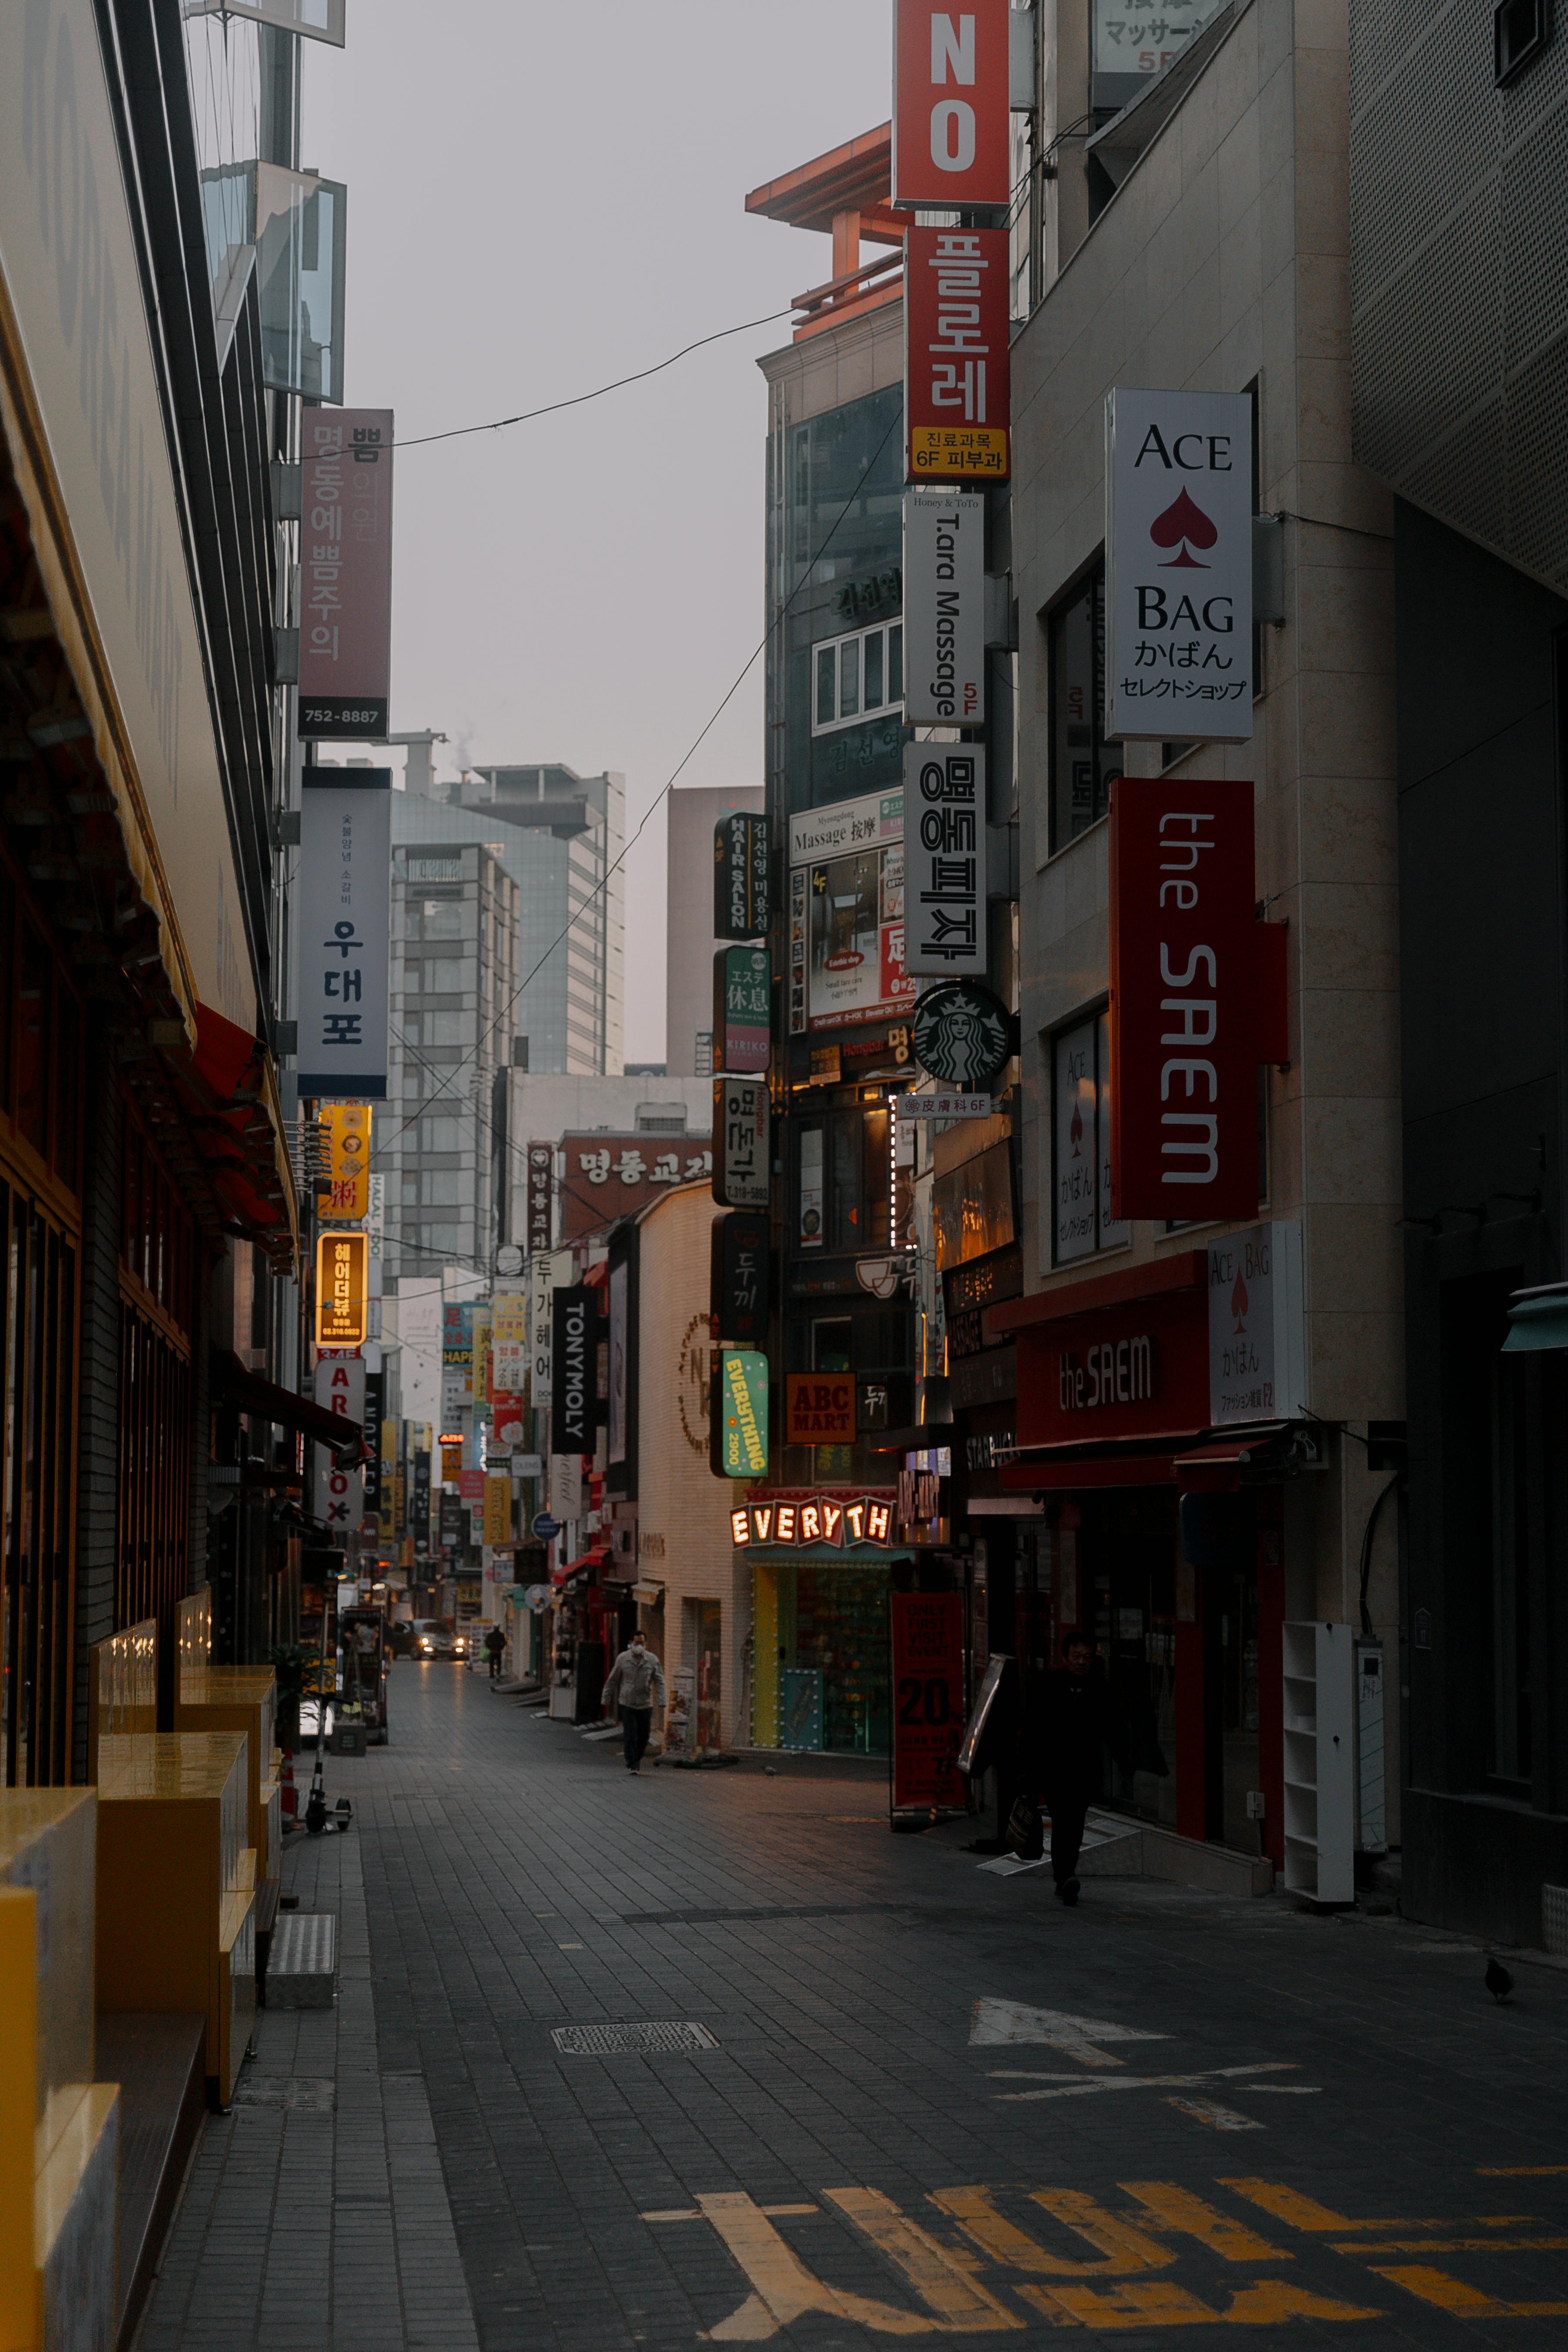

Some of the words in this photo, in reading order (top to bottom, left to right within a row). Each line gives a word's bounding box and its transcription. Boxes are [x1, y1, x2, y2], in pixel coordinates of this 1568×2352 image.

[1139, 51, 1176, 71] 5F
[930, 13, 976, 171] NO
[928, 235, 988, 423] 플로레
[926, 432, 991, 449] 진료과목
[1134, 424, 1232, 471] ACE
[917, 452, 939, 467] 6F
[948, 451, 1002, 470] 피부과
[914, 497, 942, 508] Honey
[945, 498, 952, 507] &
[955, 499, 978, 508] ToTo
[308, 426, 344, 661] 명동예쁨주의
[1134, 586, 1233, 633] BAG
[930, 592, 960, 717] Massage
[1134, 641, 1232, 669] かばん
[963, 683, 978, 716] 5F
[1120, 677, 1246, 701] セレクトショップ
[305, 710, 378, 723] 752-8887
[731, 819, 745, 866] HAIR
[754, 822, 767, 875] 김선영
[795, 827, 846, 851] Massage
[920, 756, 976, 960] 명동피자
[1159, 813, 1215, 909] the
[731, 870, 745, 928] SALON
[754, 880, 769, 931] 미용실
[322, 921, 363, 1045] 우대포
[732, 971, 763, 984] エステ
[727, 985, 769, 1012] 休息
[727, 1039, 767, 1052] KIRIKO
[1067, 1051, 1085, 1085] ACE
[756, 1086, 766, 1139] Hongbar
[921, 1099, 967, 1112] 皮膚科
[970, 1099, 985, 1112] 6F
[728, 1089, 756, 1182] 명돈가
[372, 1176, 381, 1220] HALAL
[727, 1185, 767, 1200] T.318-5892
[1061, 1166, 1092, 1205] かばん
[531, 1173, 548, 1248] 명동교자
[371, 1227, 380, 1258] FOO
[1211, 1250, 1233, 1286] ACE
[1245, 1243, 1269, 1279] BAG
[566, 1303, 584, 1438] TONYMOLY
[1223, 1342, 1259, 1377] かばん
[794, 1386, 849, 1411] ABC
[1059, 1352, 1083, 1411] the
[1263, 1383, 1273, 1408] F2
[726, 1358, 766, 1471] EVERYTHING
[1222, 1389, 1261, 1411] ファッション雑貨
[794, 1414, 849, 1431] MART
[328, 1367, 349, 1521] AROX
[365, 1392, 377, 1495] ANOTER
[729, 1433, 739, 1466] 2900
[732, 1505, 888, 1543] EVERYTH
[907, 1603, 946, 1616] ONLY
[908, 1618, 946, 1630] FIRST
[907, 1645, 949, 1657] EVENT
[909, 1632, 945, 1644] VISIT
